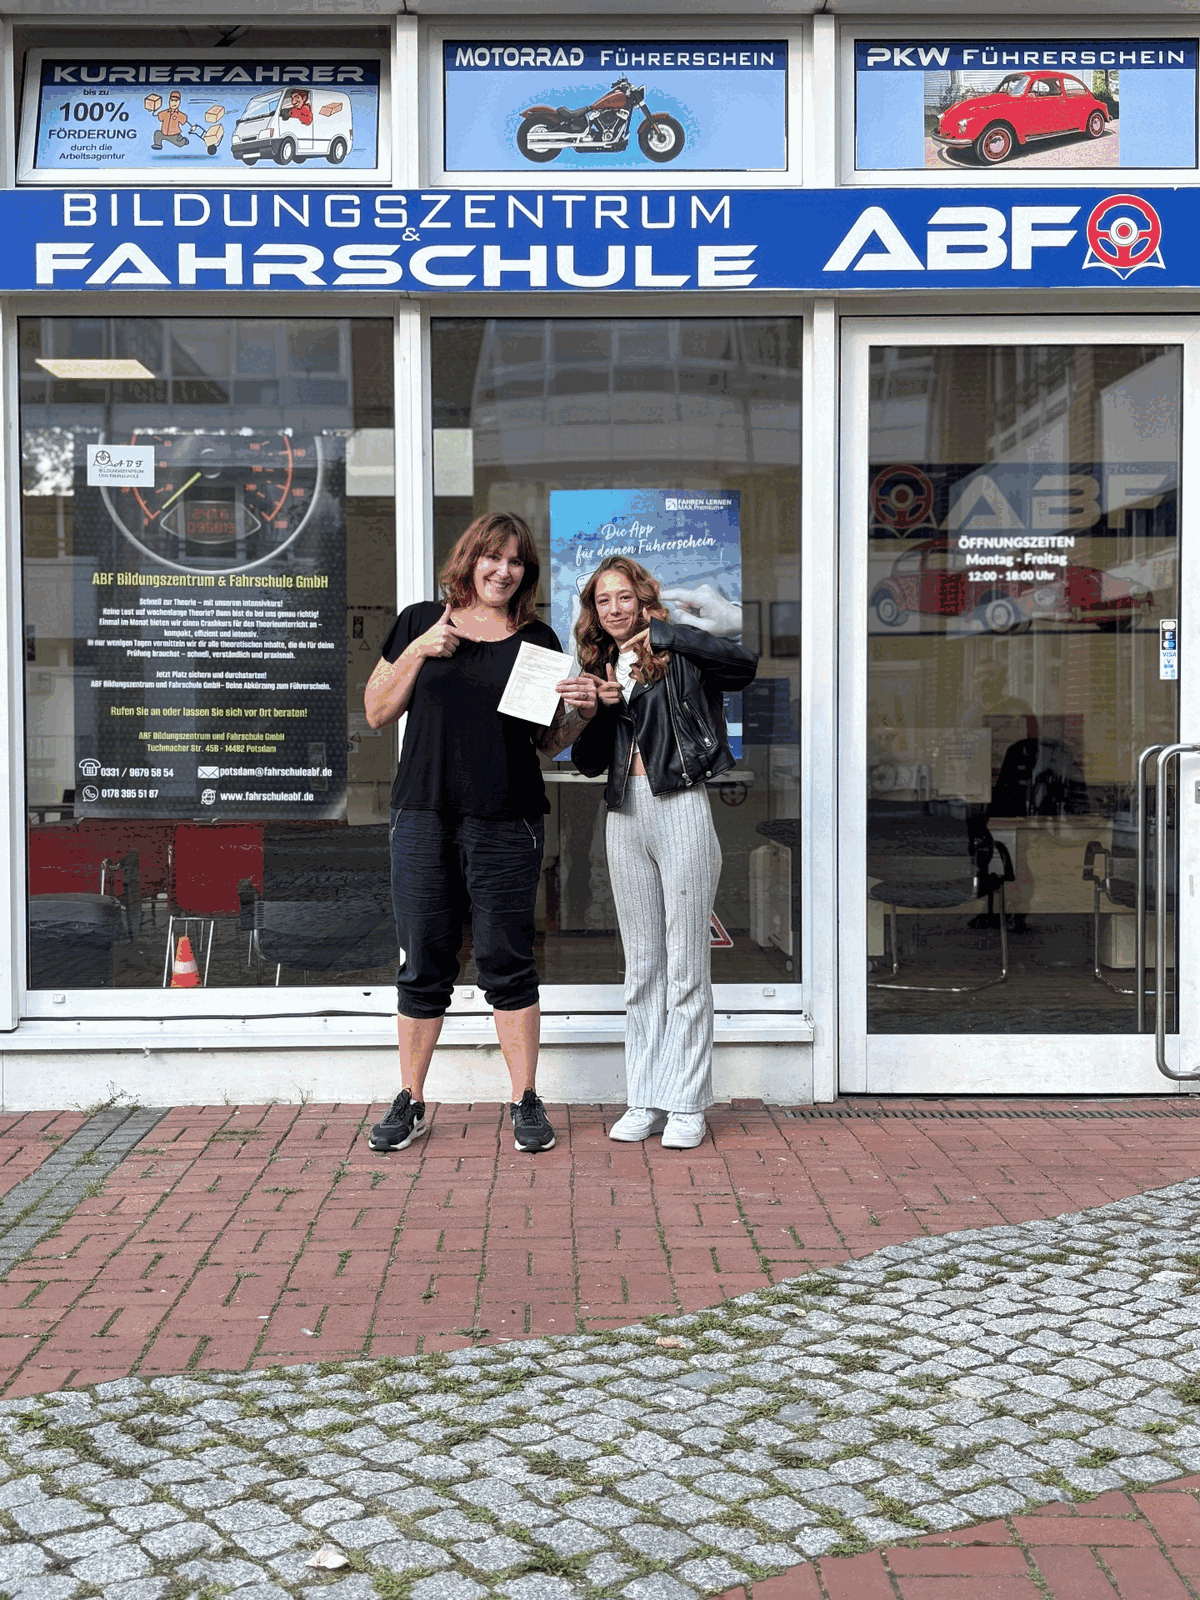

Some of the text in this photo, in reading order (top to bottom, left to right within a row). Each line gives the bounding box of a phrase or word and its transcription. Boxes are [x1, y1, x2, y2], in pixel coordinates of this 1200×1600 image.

[455, 47, 775, 67] MOTORRAD FÜHRERSCHEIN
[867, 46, 1184, 67] PKW FÜHRERSCHEIN
[54, 66, 364, 83] KURIERFAHRER
[60, 102, 130, 122] 100%
[48, 127, 137, 139] FÖRDERUNG
[59, 153, 125, 161] Arbeitsagentur
[63, 193, 730, 229] BILDUNGSZENTRUM
[402, 227, 421, 242] &
[822, 206, 1082, 272] ABF
[35, 242, 759, 287] FAHRSCHULE
[938, 474, 1168, 530] ABF
[601, 521, 655, 540] Die App
[958, 535, 1075, 549] ÖFFNUNGSZEITEN
[576, 534, 716, 566] für deinen Führerschein
[966, 554, 1014, 567] Montag
[1024, 552, 1068, 566] Freitag
[92, 572, 329, 588] ABF Bildungszentrum & Fahrschule GmbH
[968, 571, 997, 581] 12:00
[1006, 571, 1034, 581] 18:00
[1036, 570, 1056, 580] Uhr
[139, 598, 161, 606] Schnell
[174, 598, 196, 606] Theorie
[203, 599, 214, 607] mit
[242, 599, 283, 607] Intensivkurs!
[147, 609, 187, 617] wochenlange
[297, 610, 319, 619] richtig!
[164, 630, 193, 638] kompakt,
[106, 639, 133, 647] wenigen
[127, 650, 151, 658] Prüfung
[187, 650, 211, 659] schnell,
[103, 680, 155, 689] Bildungszentrum
[244, 682, 275, 690] Abkürzung
[110, 706, 134, 716] Rufen
[136, 706, 149, 716] Sie
[162, 707, 181, 716] oder
[182, 707, 210, 716] lassen
[211, 707, 223, 716] Sie
[225, 707, 242, 716] sich
[259, 707, 272, 717] Ort
[273, 708, 307, 717] beraten!
[152, 732, 211, 741] Bildungszentrum
[101, 767, 174, 777] 0331 / 9679 58 54
[220, 767, 332, 777] potsdam@fahrschuleabf.de
[101, 789, 159, 798] 0178 395 51 87
[220, 792, 314, 801] www.fahrschuleabf.de
